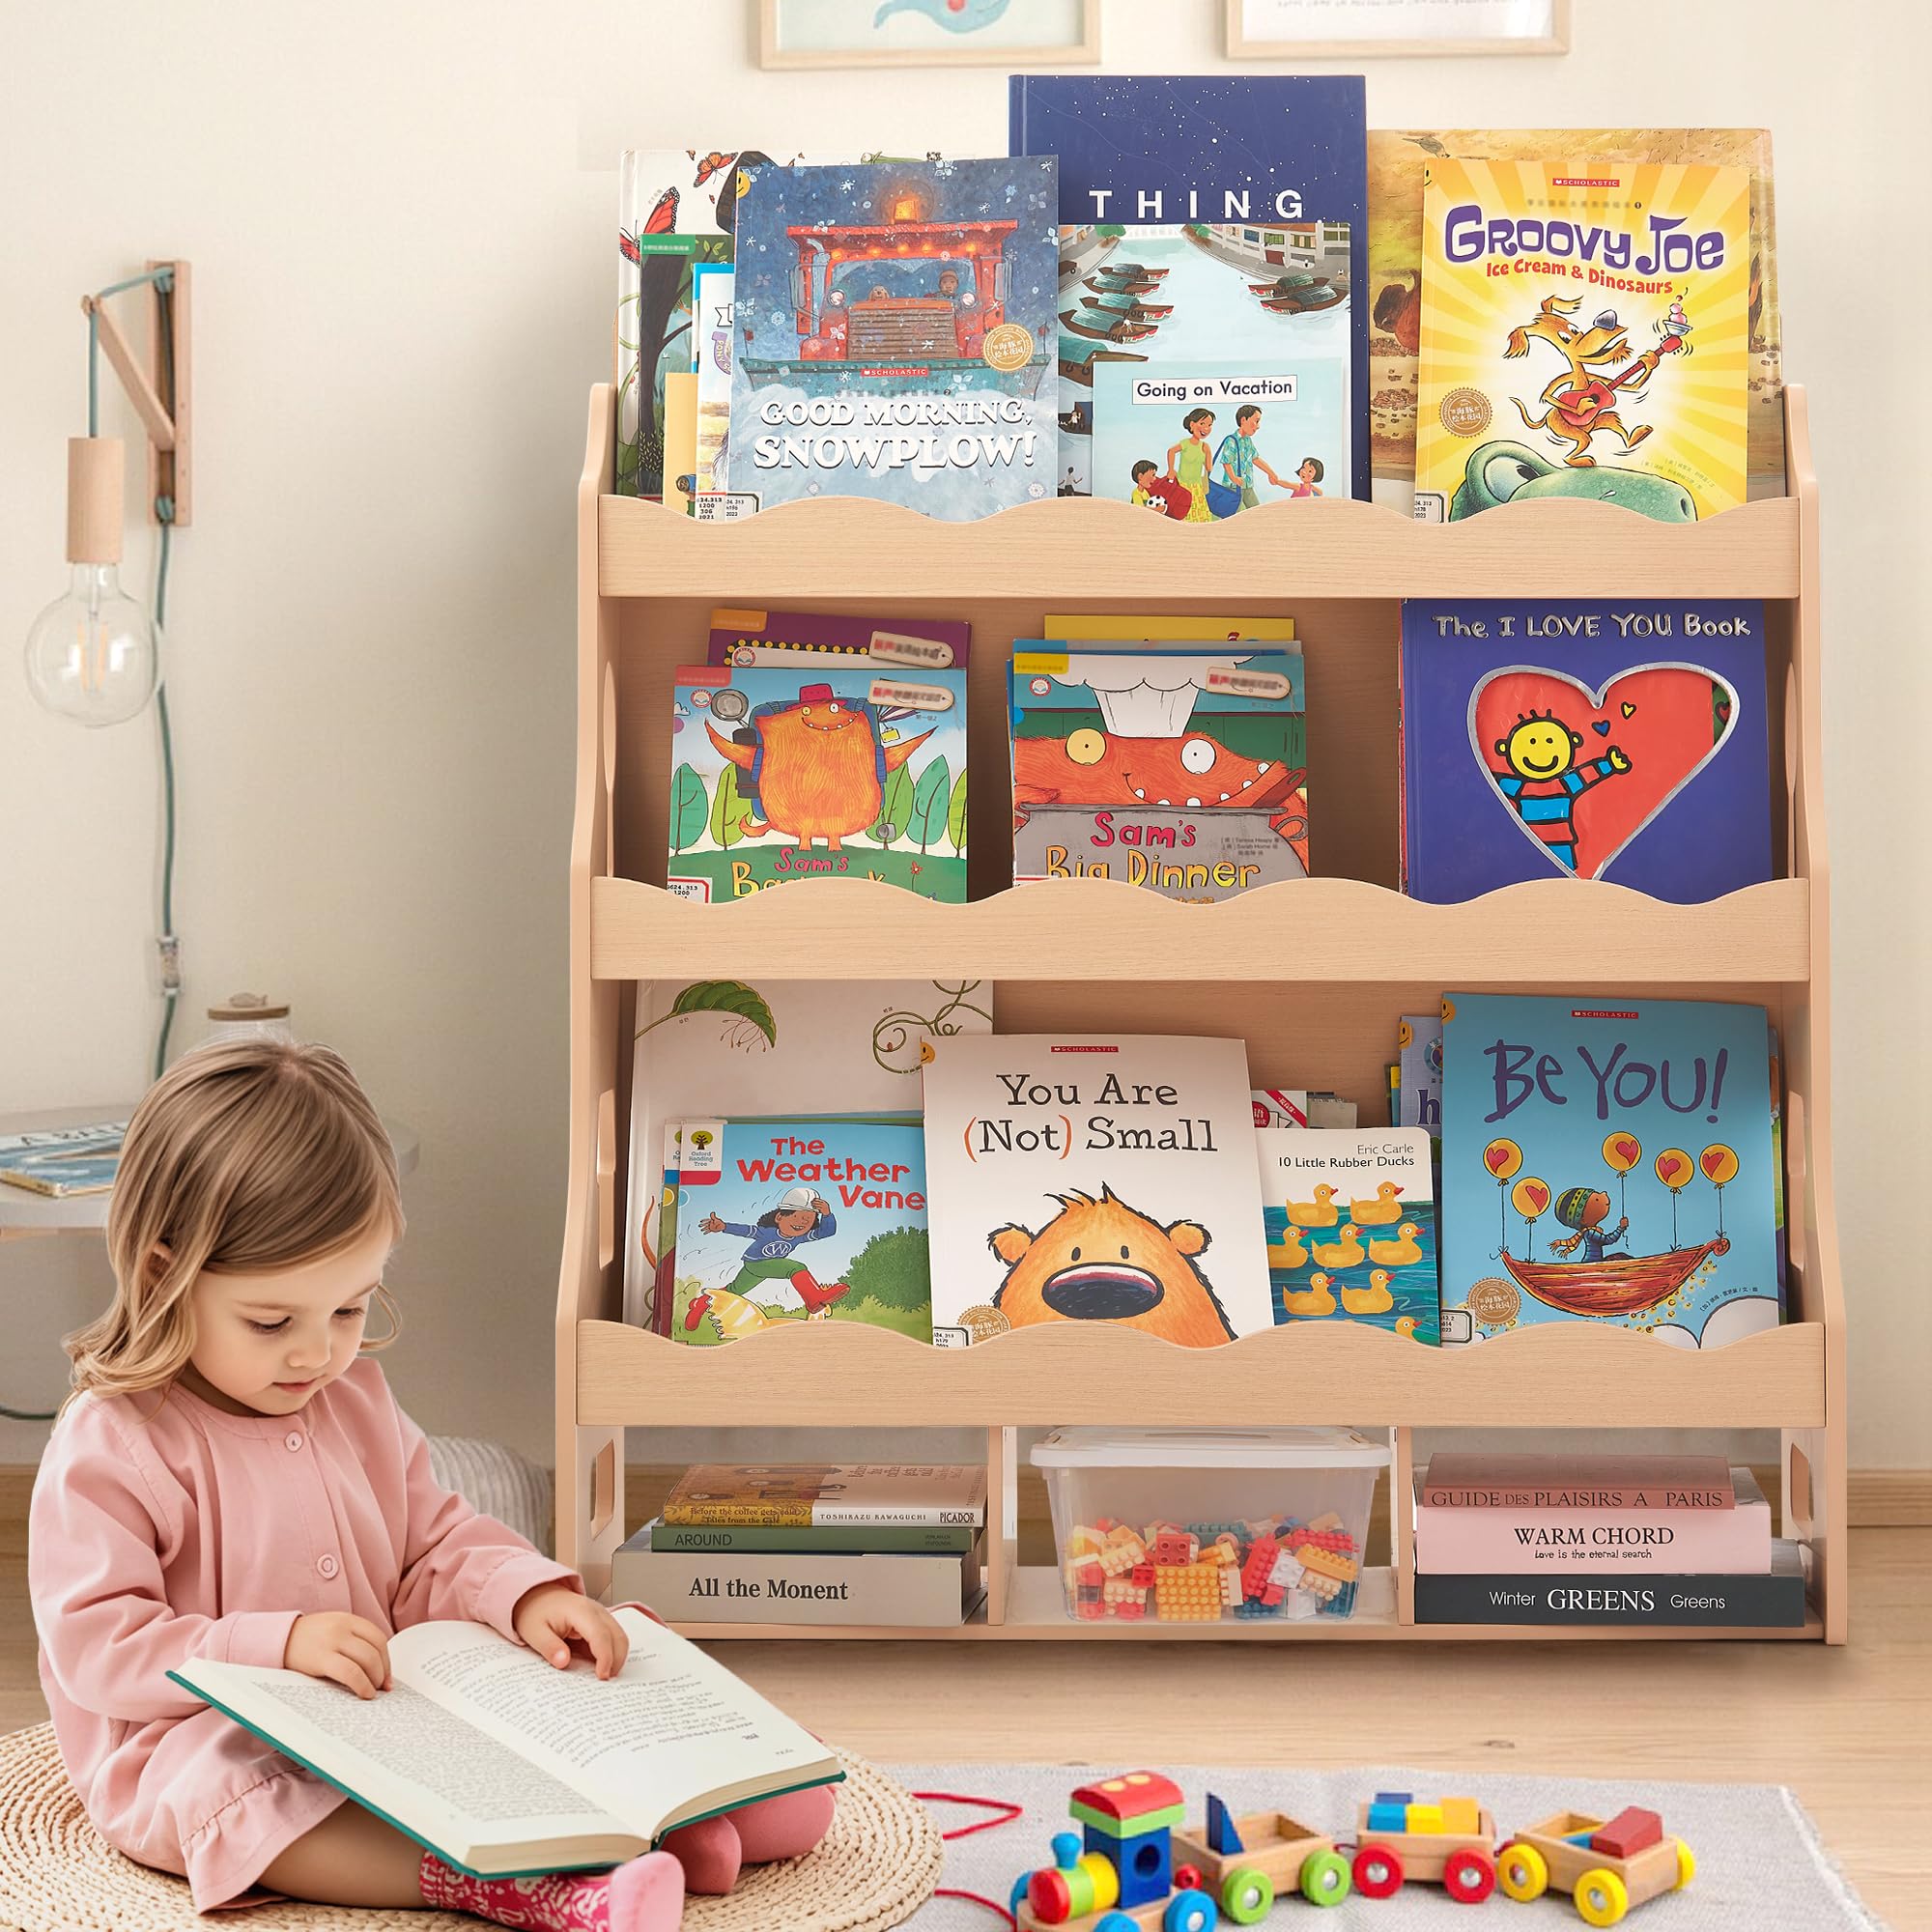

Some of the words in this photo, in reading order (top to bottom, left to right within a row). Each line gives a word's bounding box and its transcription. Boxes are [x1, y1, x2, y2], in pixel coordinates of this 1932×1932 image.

[1089, 189, 1303, 218] THING
[1487, 262, 1509, 277] Ice
[1514, 258, 1567, 276] Cream
[1571, 267, 1584, 279] &
[1588, 269, 1673, 295] Dinosaurs
[1137, 382, 1186, 401] Going
[1194, 384, 1213, 397] on
[1220, 380, 1293, 395] Vacation
[759, 400, 855, 426] GOOD
[864, 398, 1034, 427] MORNING,
[753, 430, 1038, 469] SNOWPLOW!
[1432, 613, 1489, 639] The
[1497, 615, 1516, 638] I
[1525, 613, 1602, 638] LOVE
[1610, 612, 1673, 639] YOU
[1683, 612, 1752, 638] Book
[1090, 811, 1197, 848] Sam's
[775, 846, 850, 872] Sam's
[1127, 848, 1261, 889] Dinner
[1579, 1010, 1637, 1019] SCHOLASTIC
[996, 1073, 1081, 1106] You
[1094, 1072, 1179, 1105] Are
[1484, 1038, 1568, 1123] Be
[770, 1135, 826, 1156] The
[963, 1114, 1073, 1163] (Not)
[1086, 1116, 1218, 1152] Small
[1357, 1144, 1378, 1155] Eric
[1382, 1143, 1414, 1154] Carle
[736, 1157, 911, 1183] Weather
[1278, 1157, 1292, 1167] 10
[1295, 1156, 1325, 1168] Little
[1330, 1156, 1373, 1168] Rubber
[1378, 1155, 1414, 1167] Ducks
[837, 1183, 925, 1210] Vane
[720, 1507, 733, 1516] the
[734, 1507, 758, 1516] coffee
[1431, 1492, 1500, 1507] GUIDE
[1504, 1492, 1530, 1506] DES
[1534, 1492, 1623, 1507] PLAISIRS
[1634, 1492, 1648, 1507] A
[1665, 1492, 1723, 1507] PARIS
[939, 1512, 975, 1523] PICADOR
[674, 1533, 732, 1547] AROUND
[1514, 1527, 1585, 1546] WARM
[1592, 1527, 1674, 1546] CHORD
[1534, 1549, 1554, 1559] Love
[1558, 1549, 1567, 1559] is
[1572, 1549, 1585, 1559] the
[1589, 1549, 1619, 1559] eternal
[1622, 1549, 1652, 1559] search
[688, 1577, 720, 1598] All
[726, 1577, 761, 1598] the
[767, 1578, 849, 1601] Monent
[1489, 1590, 1536, 1606] Winter
[1547, 1588, 1656, 1611] GREENS
[1670, 1593, 1726, 1609] Greens
